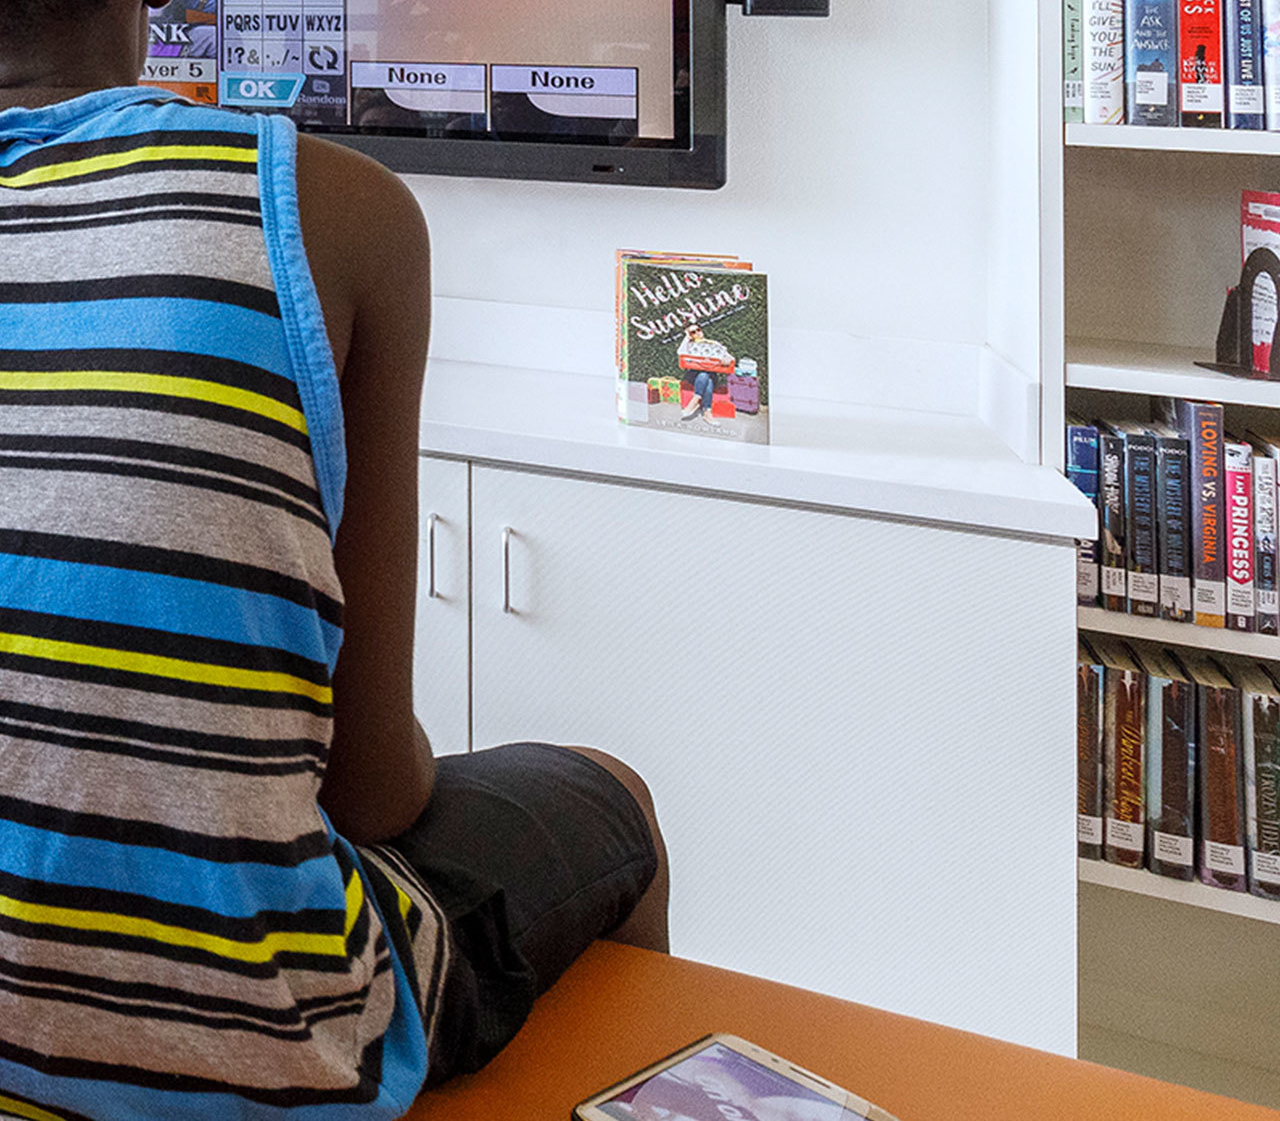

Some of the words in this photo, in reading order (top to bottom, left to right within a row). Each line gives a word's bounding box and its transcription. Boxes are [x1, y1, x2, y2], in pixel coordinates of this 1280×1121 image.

[225, 14, 260, 32] PQRS
[264, 15, 300, 31] TUV
[305, 15, 342, 32] WXYZ
[1088, 15, 1117, 27] GIVE
[1139, 15, 1162, 28] ASK
[1239, 9, 1252, 23] OF
[1090, 31, 1118, 43] YOU
[1240, 24, 1252, 37] US
[1091, 47, 1115, 57] THE
[1240, 38, 1253, 58] JUST
[189, 62, 204, 78] 5
[387, 66, 447, 85] None
[1090, 62, 1116, 72] SUN
[1241, 59, 1253, 80] LIVE
[530, 70, 596, 90] None
[239, 80, 276, 99] OK
[630, 283, 751, 341] Sunshine
[1200, 420, 1218, 478] LOVING
[1235, 480, 1245, 494] AM
[1202, 503, 1218, 564] VIRGINIA
[1231, 495, 1250, 580] PRINCESS
